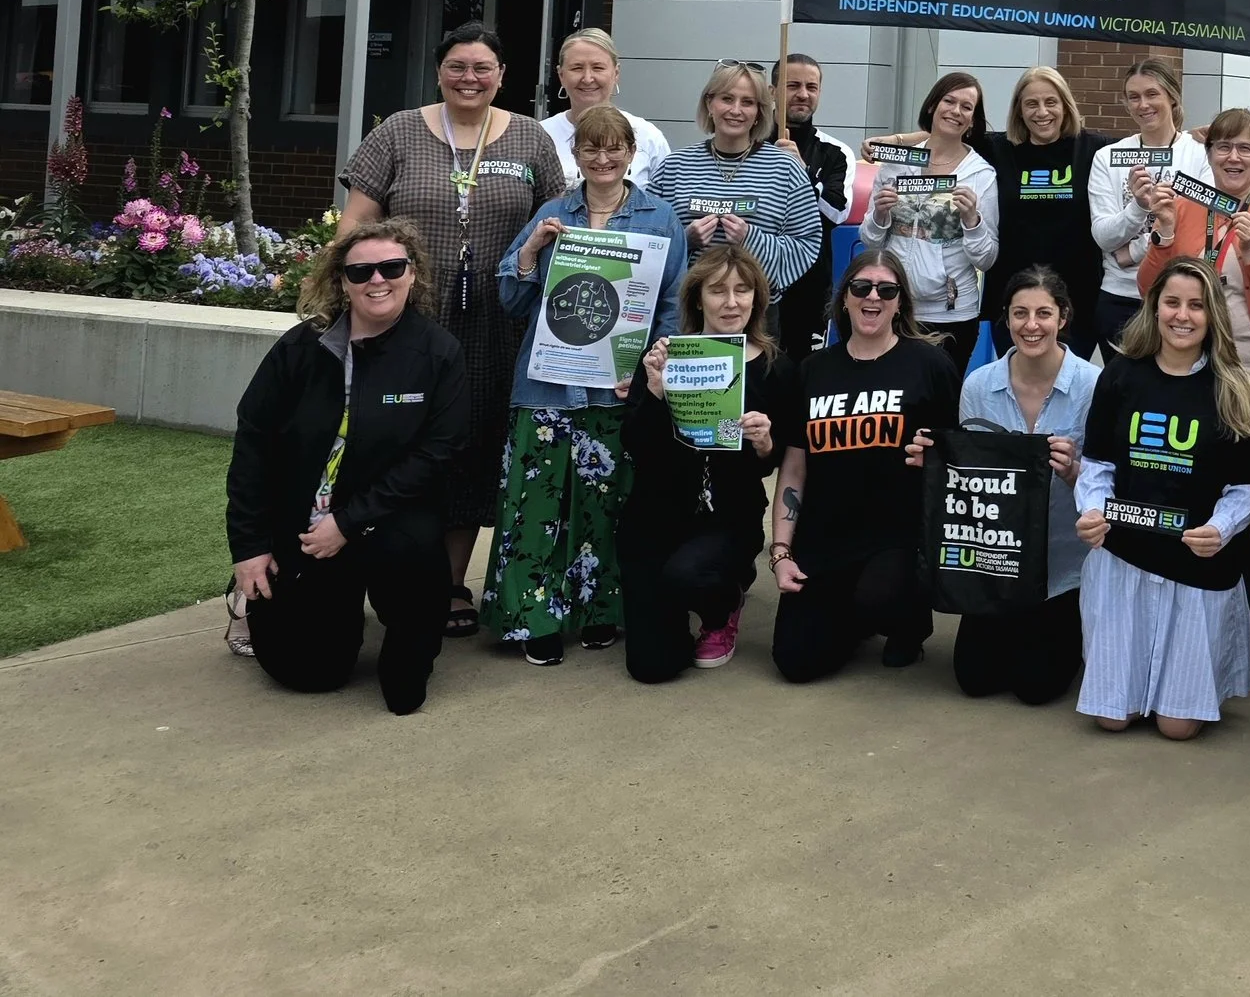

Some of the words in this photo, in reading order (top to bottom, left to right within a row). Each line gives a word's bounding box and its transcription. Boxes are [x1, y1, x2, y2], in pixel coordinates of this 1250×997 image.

[951, 4, 1039, 24] EDUCATION
[1044, 12, 1095, 29] UNION
[1099, 16, 1166, 35] VICTORIA
[1170, 21, 1246, 41] TASMANIA
[880, 153, 907, 162] UNION
[909, 151, 928, 161] IEU
[1152, 152, 1171, 162] IEU
[491, 168, 522, 177] UNION
[512, 163, 523, 171] TO
[1021, 165, 1072, 185] IEU
[936, 179, 955, 188] IEU
[1176, 175, 1203, 192] PROUD
[1204, 188, 1216, 198] TO
[1173, 182, 1183, 192] BE
[1184, 187, 1213, 205] UNION
[691, 199, 720, 207] PROUD
[735, 202, 755, 211] IEU
[1215, 196, 1237, 212] IEU
[702, 206, 732, 214] UNION
[608, 236, 623, 244] win
[648, 241, 665, 250] IEU
[560, 243, 591, 255] salary
[591, 247, 639, 260] increases
[554, 260, 581, 268] industrial
[581, 263, 601, 271] rights?
[619, 336, 632, 344] Sign
[667, 362, 727, 373] Statement
[667, 375, 678, 384] of
[680, 374, 725, 386] Support
[383, 394, 403, 404] IEU
[810, 393, 848, 419] WE
[851, 390, 904, 415] ARE
[810, 416, 899, 451] UNION
[1129, 411, 1199, 451] IEU
[1130, 460, 1149, 468] PROUD
[1168, 465, 1192, 474] UNION
[946, 468, 1017, 495] Proud
[945, 493, 967, 515] to
[971, 496, 1000, 520] be
[1106, 501, 1141, 515] PROUD
[1143, 508, 1157, 517] TO
[1105, 511, 1118, 520] BE
[1120, 512, 1155, 527] UNION
[1159, 512, 1185, 528] IEU
[943, 522, 1022, 547] union.
[940, 547, 975, 566] IEU
[976, 551, 1008, 559] INDEPENDENT
[976, 556, 1001, 565] EDUCATION
